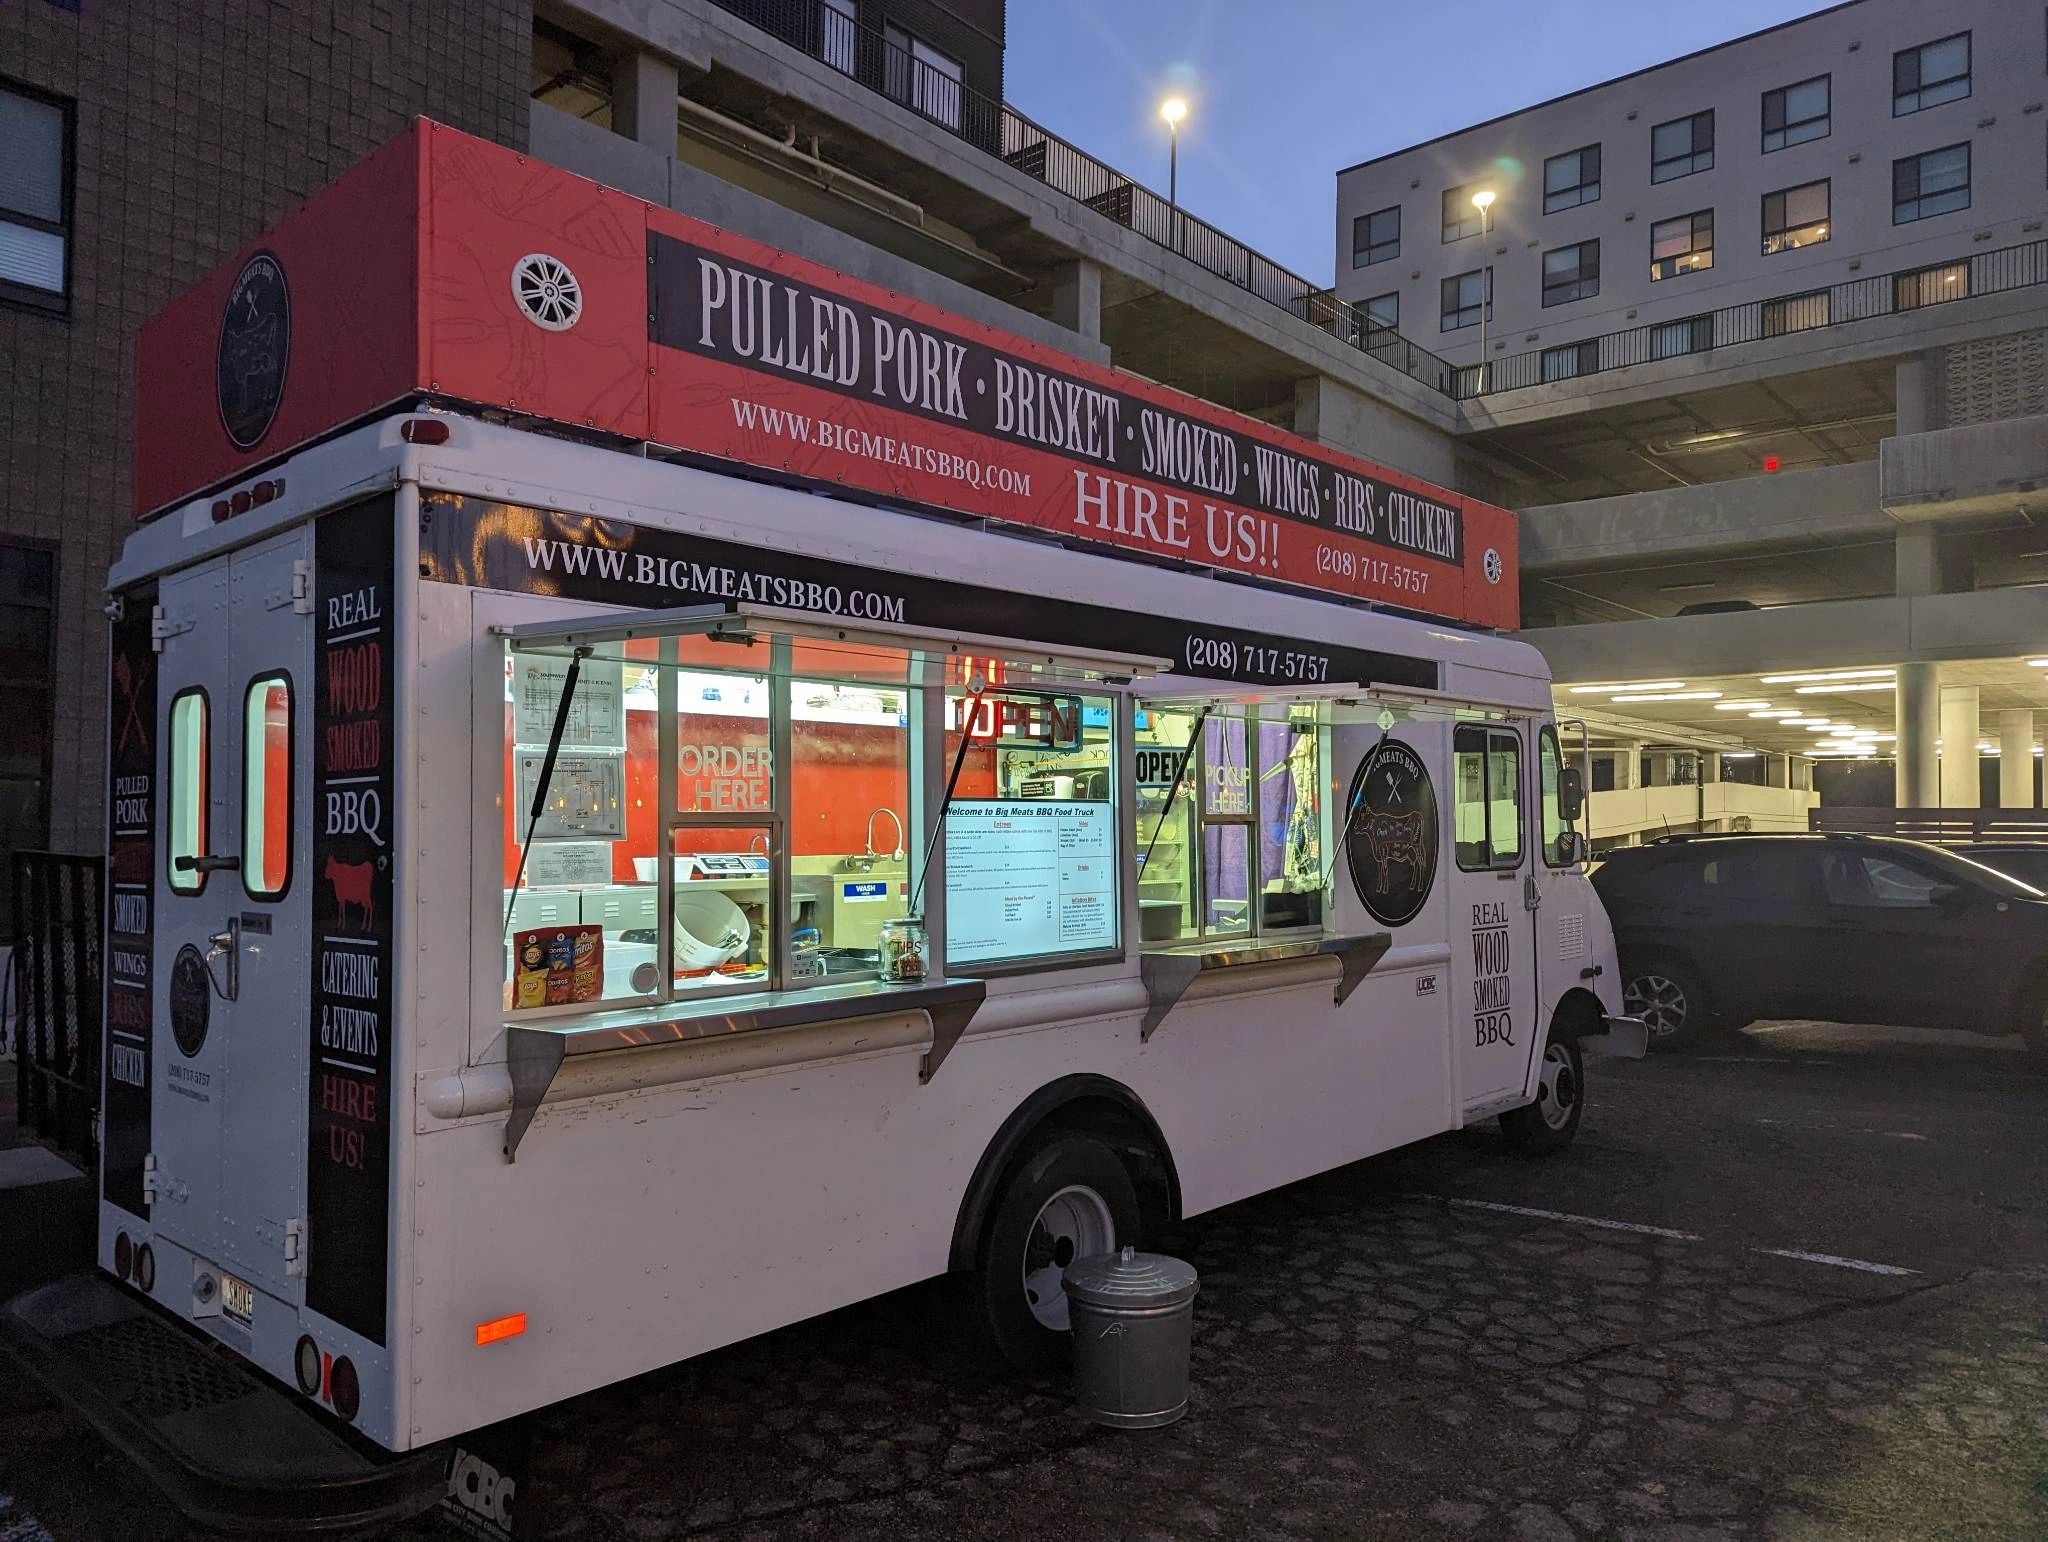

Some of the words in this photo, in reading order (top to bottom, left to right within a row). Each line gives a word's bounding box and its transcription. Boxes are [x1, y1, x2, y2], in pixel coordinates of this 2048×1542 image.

[697, 257, 861, 387] PULLED
[871, 315, 968, 421] PORK
[993, 356, 1121, 463] BRISKET
[1140, 408, 1237, 497] SMOKED
[1254, 445, 1320, 520] WINGS
[1335, 472, 1376, 536] RIBS
[1388, 491, 1455, 560] CHICKEN
[730, 398, 1031, 497] WWW.BIGMEATSBBQ.COM
[1073, 469, 1191, 549] HIRE
[1204, 503, 1280, 569] US!!
[523, 536, 905, 623] WWW.BIGMEATSBBQ.COM
[1316, 543, 1357, 582] (208)
[1361, 557, 1430, 594] 717-5757
[327, 586, 381, 631] REAL
[327, 642, 382, 716] WOOD
[1185, 633, 1238, 672] (208)
[1243, 645, 1329, 682] 717-5757
[962, 696, 1077, 742] OPEN
[326, 718, 380, 773] SMOKED
[679, 744, 773, 777] ORDER
[1135, 751, 1188, 784] OPEN
[1379, 750, 1404, 766] MEATS
[1404, 756, 1419, 781] BBQ
[116, 775, 149, 796] PULLED
[695, 779, 765, 811] HERE
[1212, 790, 1246, 813] HERE
[115, 798, 148, 825] PORK
[326, 788, 386, 846] BBQ
[984, 807, 994, 817] to
[995, 807, 1010, 819] Big
[1010, 808, 1034, 817] Meats
[1035, 807, 1053, 817] BBQ
[1054, 808, 1073, 816] Food
[1074, 808, 1095, 816] Truck
[114, 894, 148, 936] SMOKED
[1471, 902, 1509, 927] REAL
[114, 951, 147, 977] WINGS
[893, 940, 922, 954] TIPS
[1472, 930, 1510, 975] WOOD
[322, 950, 379, 1000] CATERING
[1473, 975, 1511, 1012] SMOKED
[321, 1004, 330, 1047] &
[332, 1004, 379, 1057] EVENTS
[1475, 1013, 1516, 1048] BBQ
[112, 1043, 146, 1088] CHICKEN
[321, 1074, 378, 1122] HIRE
[328, 1125, 366, 1170] US!
